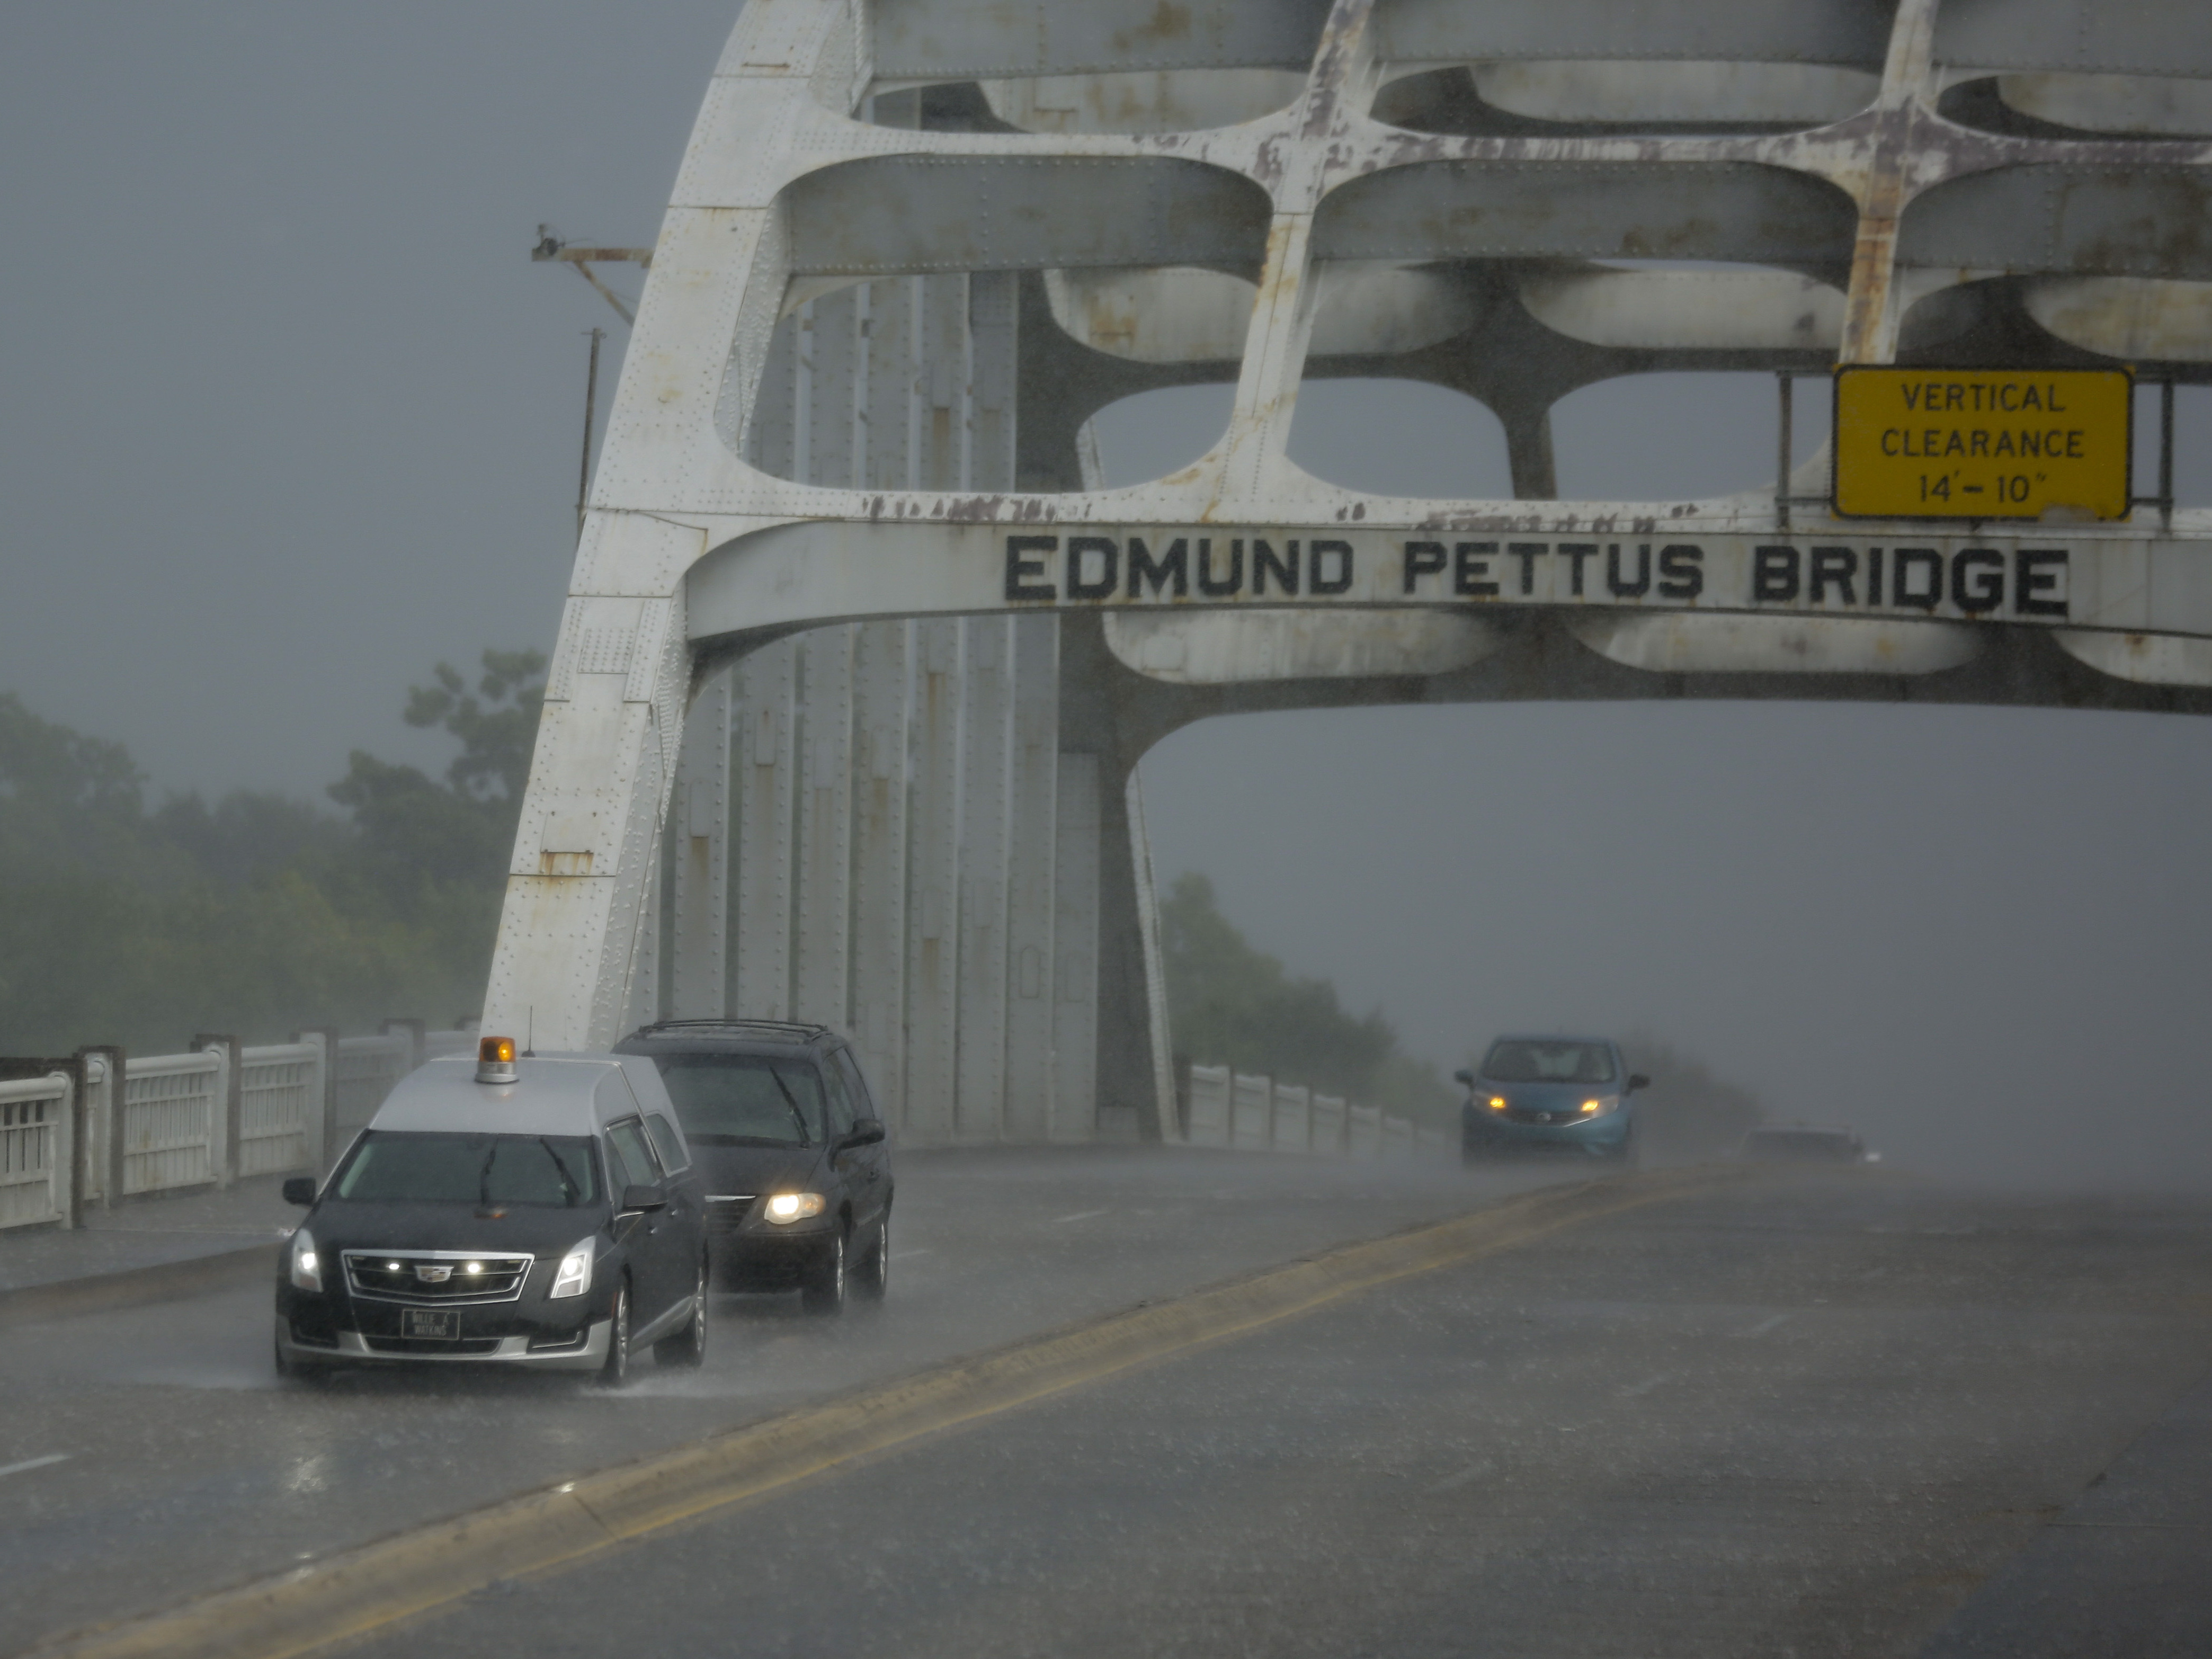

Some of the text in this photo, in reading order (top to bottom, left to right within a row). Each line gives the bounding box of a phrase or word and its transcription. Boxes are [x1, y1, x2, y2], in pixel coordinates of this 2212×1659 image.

[1902, 383, 2066, 412] VERTICAL
[1881, 429, 2084, 458] CLEARANCE
[1005, 536, 2068, 616] EDMUND PETTUS BRIDGE
